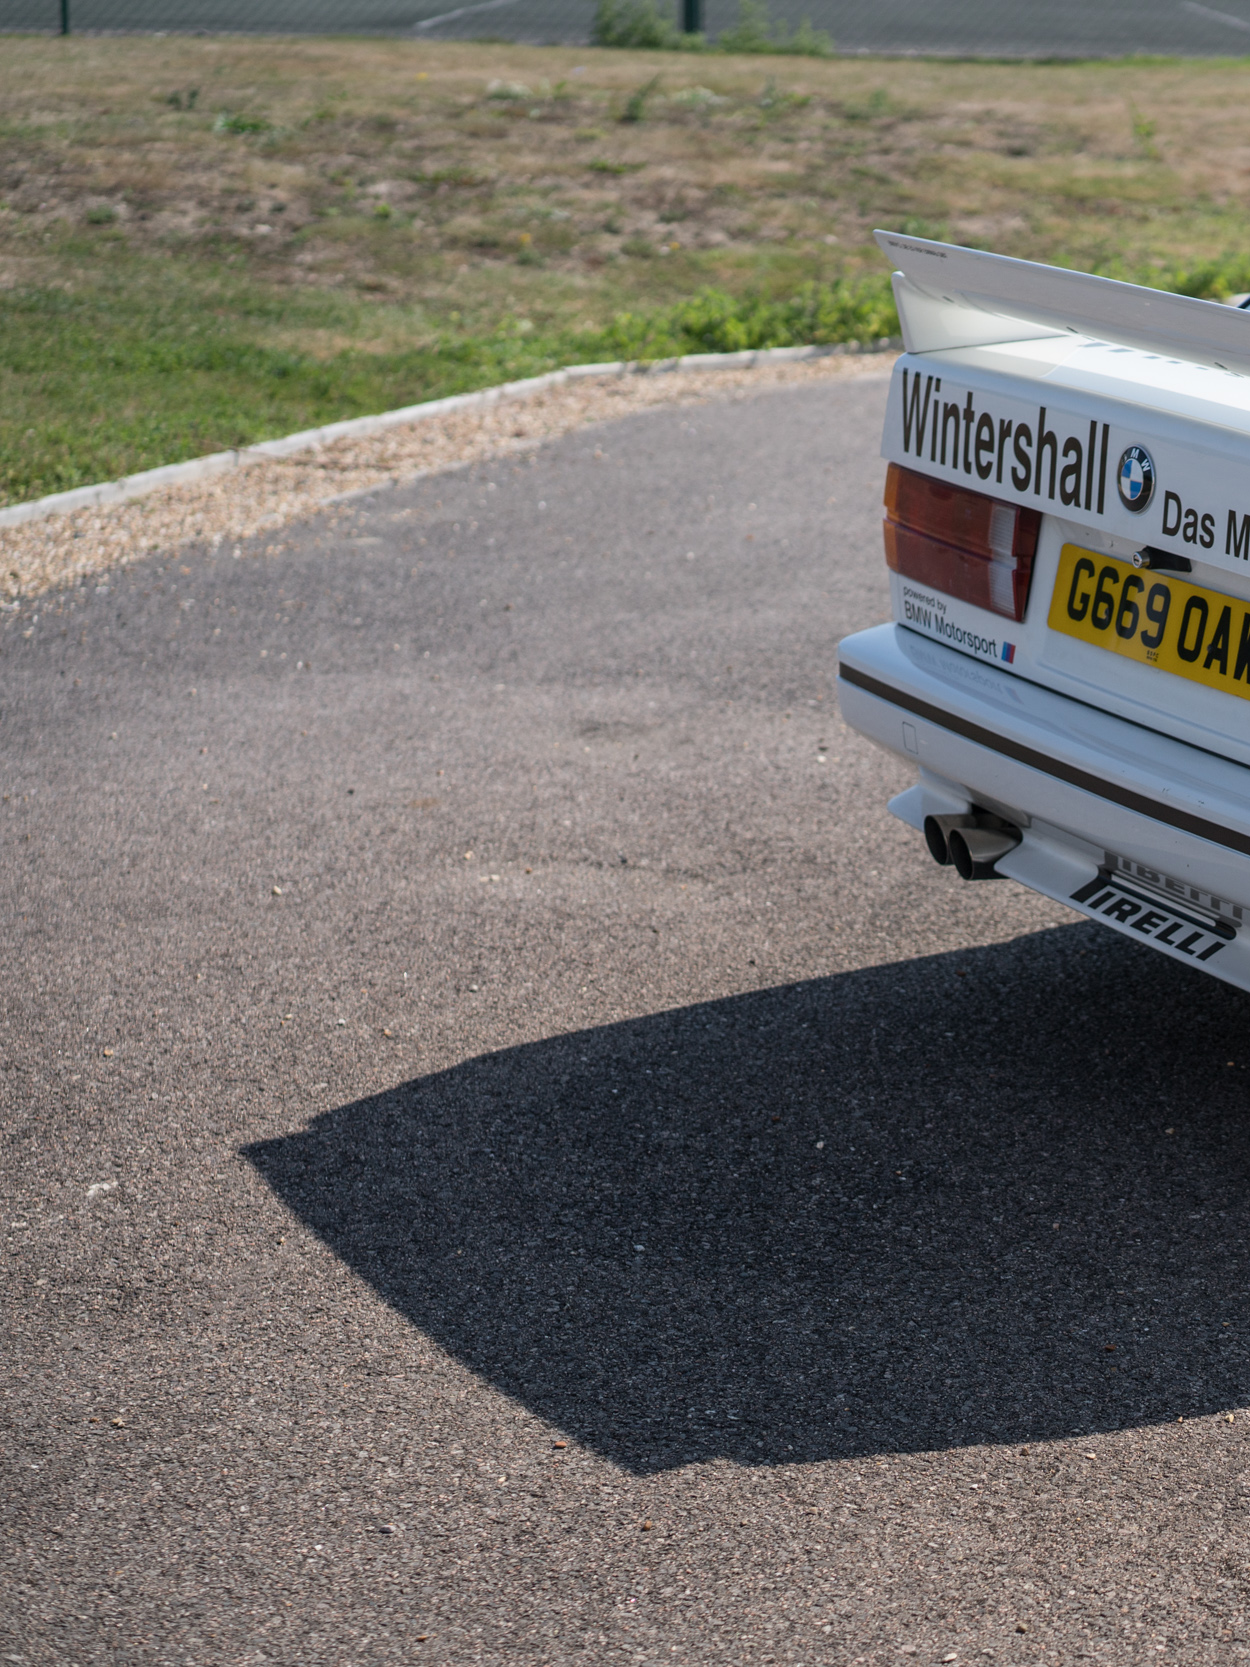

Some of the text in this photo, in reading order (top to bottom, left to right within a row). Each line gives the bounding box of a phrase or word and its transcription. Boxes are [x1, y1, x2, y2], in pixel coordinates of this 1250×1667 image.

[902, 367, 1110, 515] Wintershall
[1161, 489, 1216, 549] Das
[903, 586, 948, 615] powered by
[904, 600, 998, 658] BMW Motorsport
[1066, 557, 1172, 650] G669
[1069, 862, 1237, 962] PIRELLI
